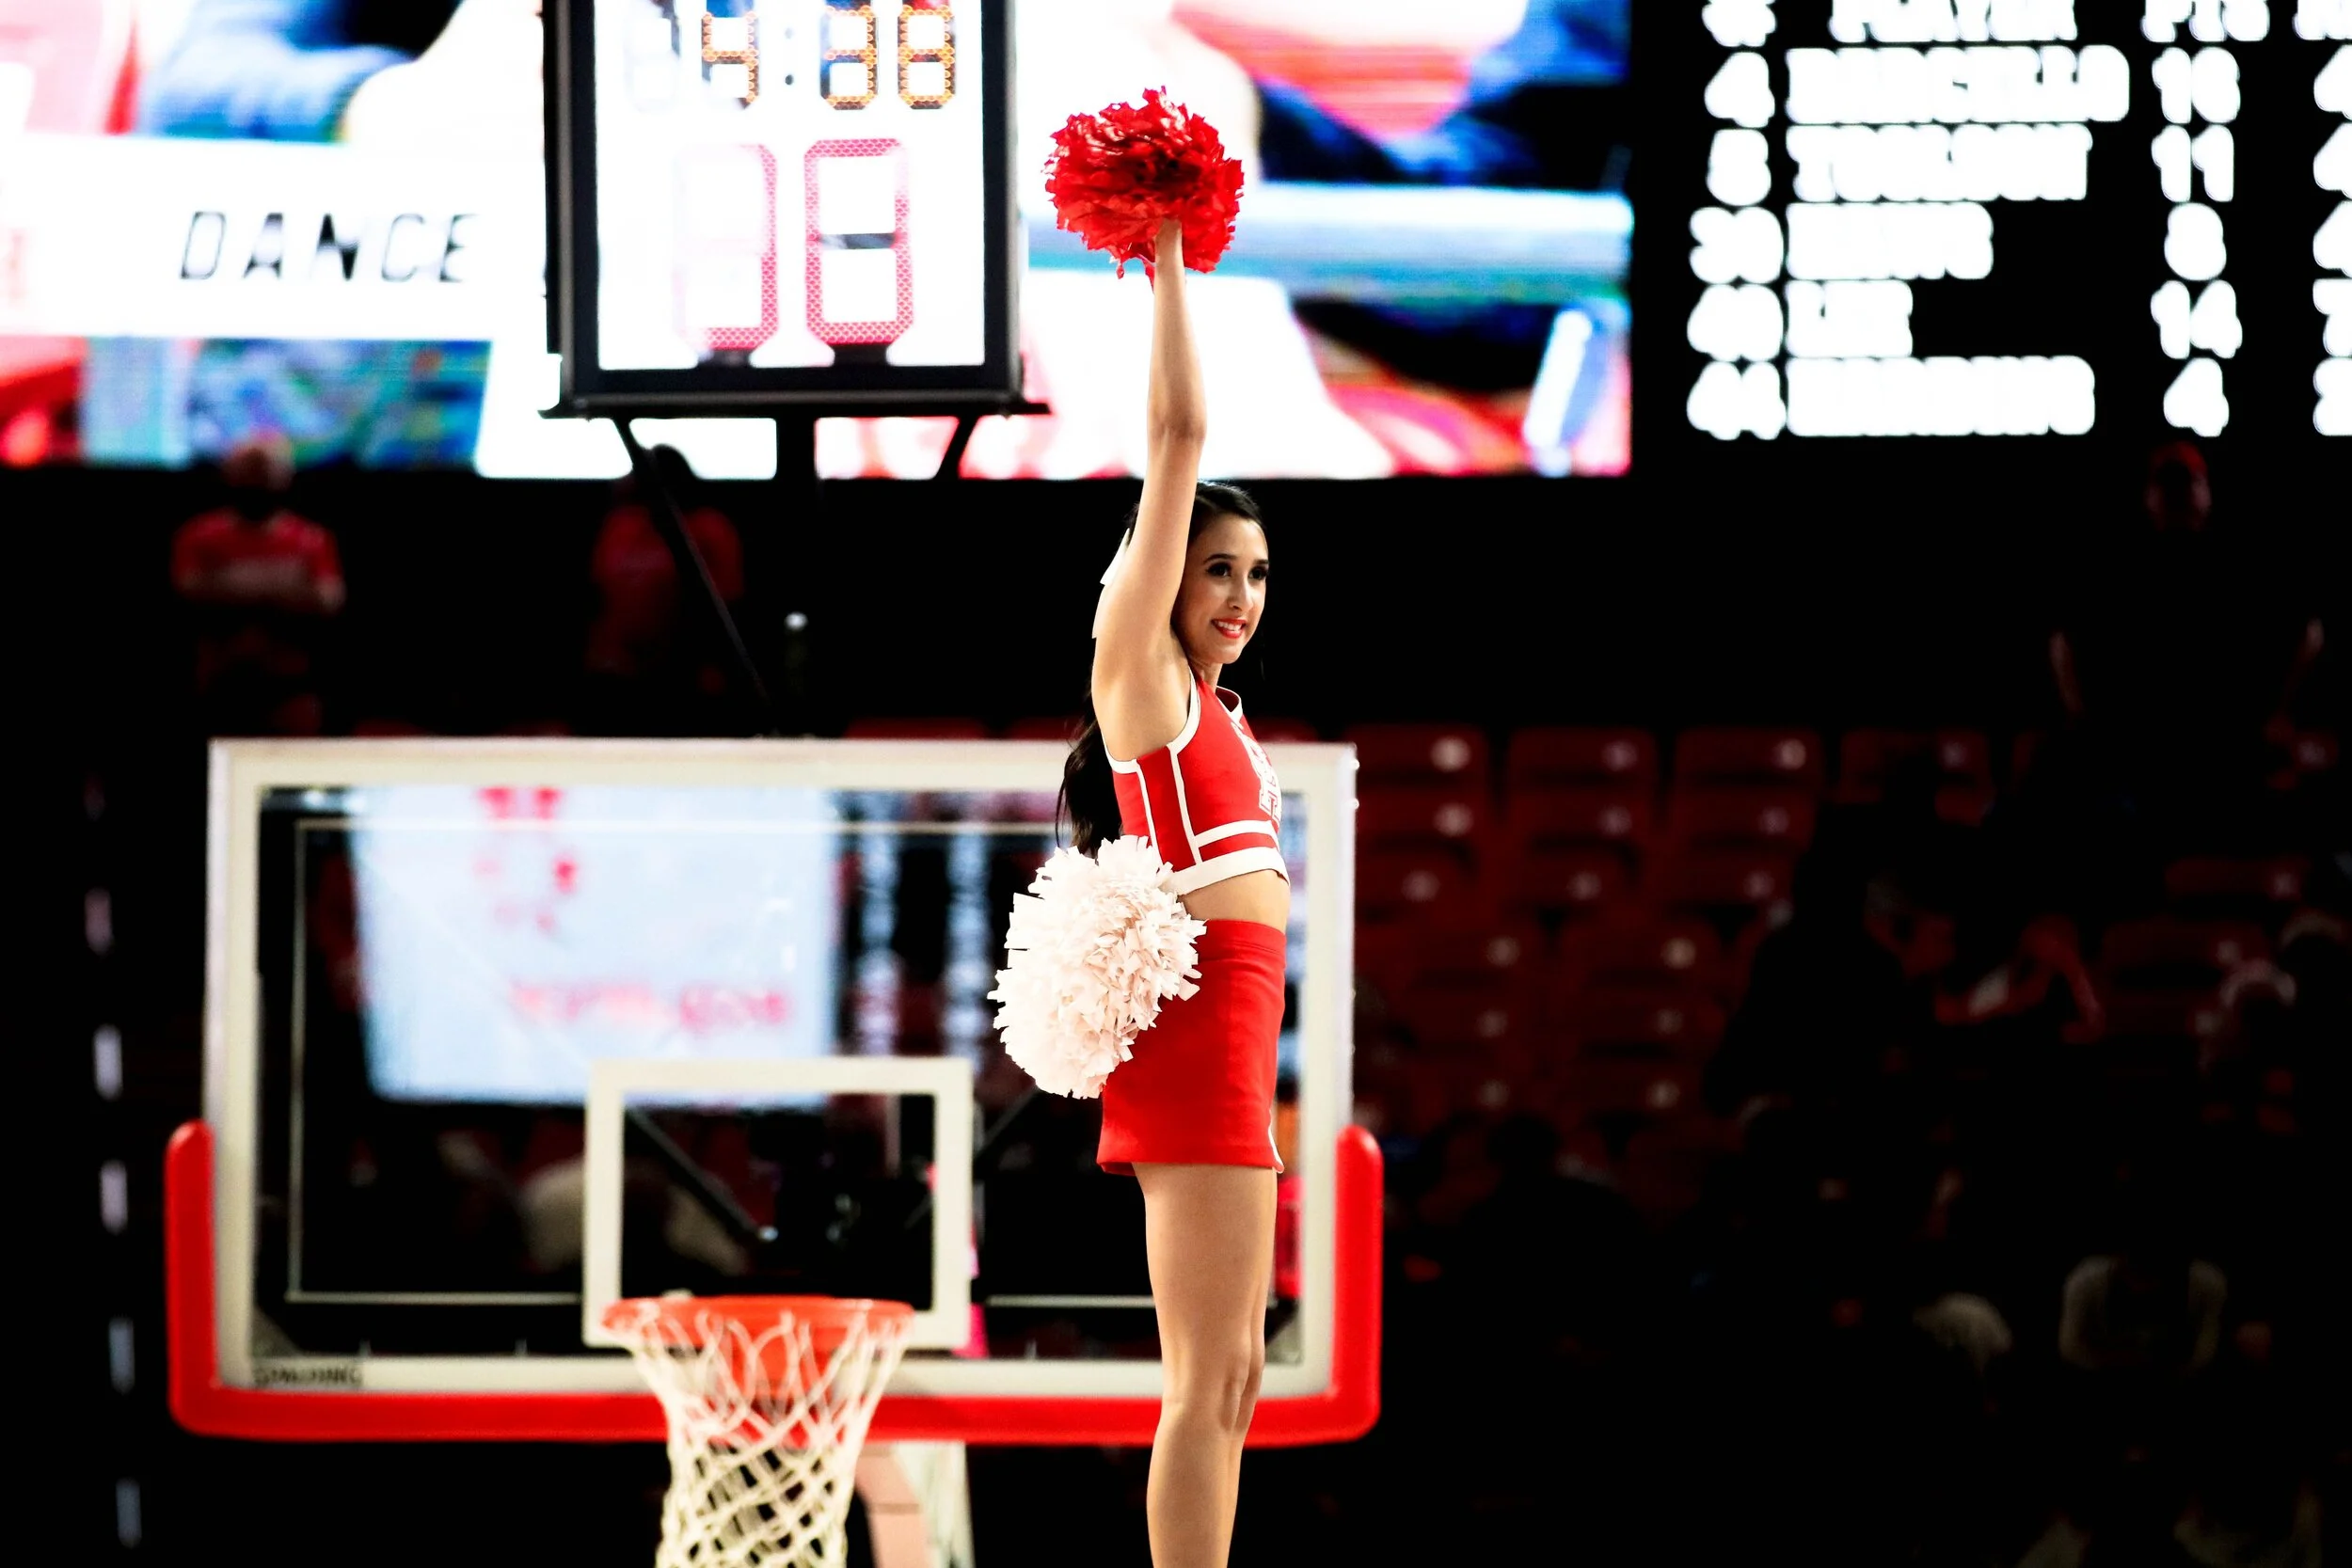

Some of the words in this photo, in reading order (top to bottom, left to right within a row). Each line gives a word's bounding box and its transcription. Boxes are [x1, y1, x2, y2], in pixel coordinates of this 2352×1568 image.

[1705, 52, 1775, 128] 4
[2152, 124, 2233, 202] 11
[180, 210, 479, 283] DANCE
[2151, 280, 2242, 359] 14
[2164, 357, 2229, 436] 4
